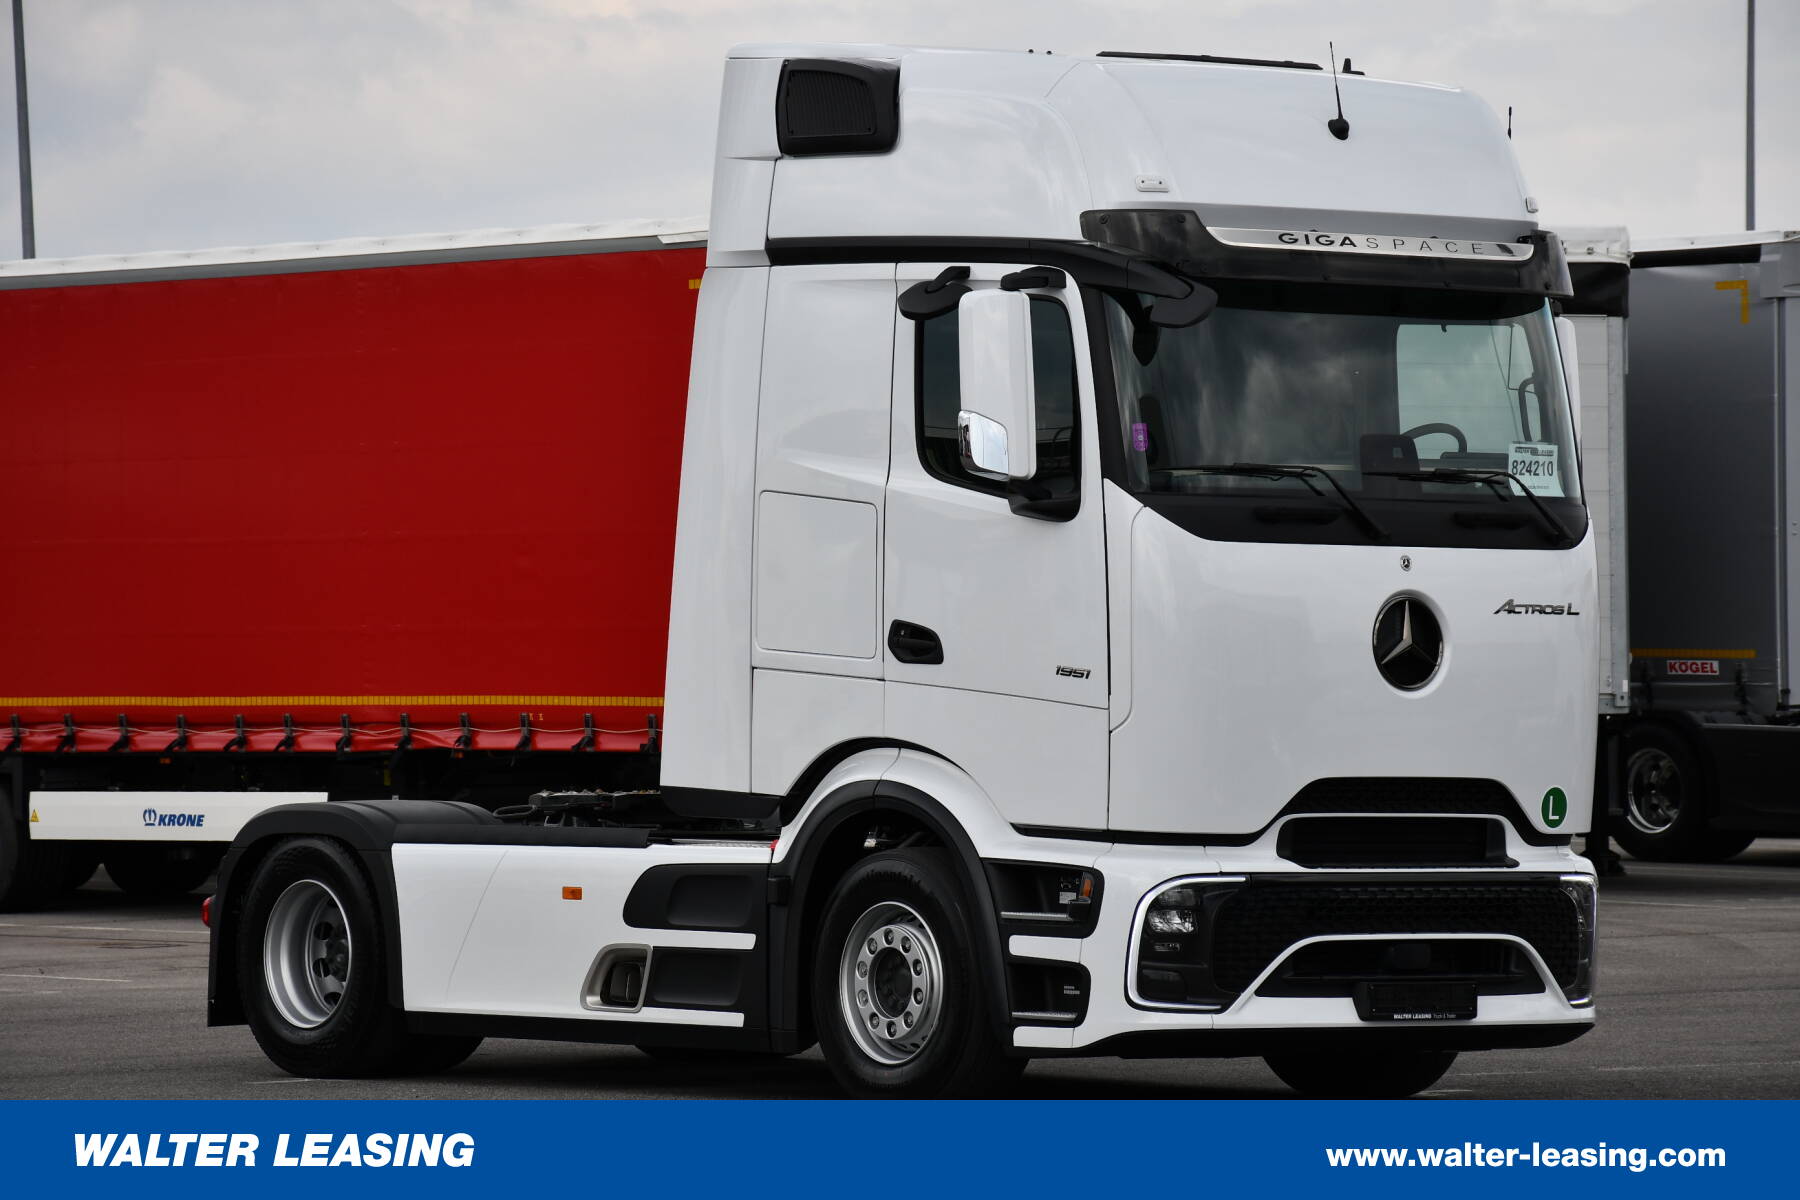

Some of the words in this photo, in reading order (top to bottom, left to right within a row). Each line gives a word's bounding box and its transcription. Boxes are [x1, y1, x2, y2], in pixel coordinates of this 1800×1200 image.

[1511, 460, 1554, 476] 824210
[1056, 665, 1091, 679] 1951
[1549, 795, 1559, 820] L
[158, 813, 205, 827] KRONE
